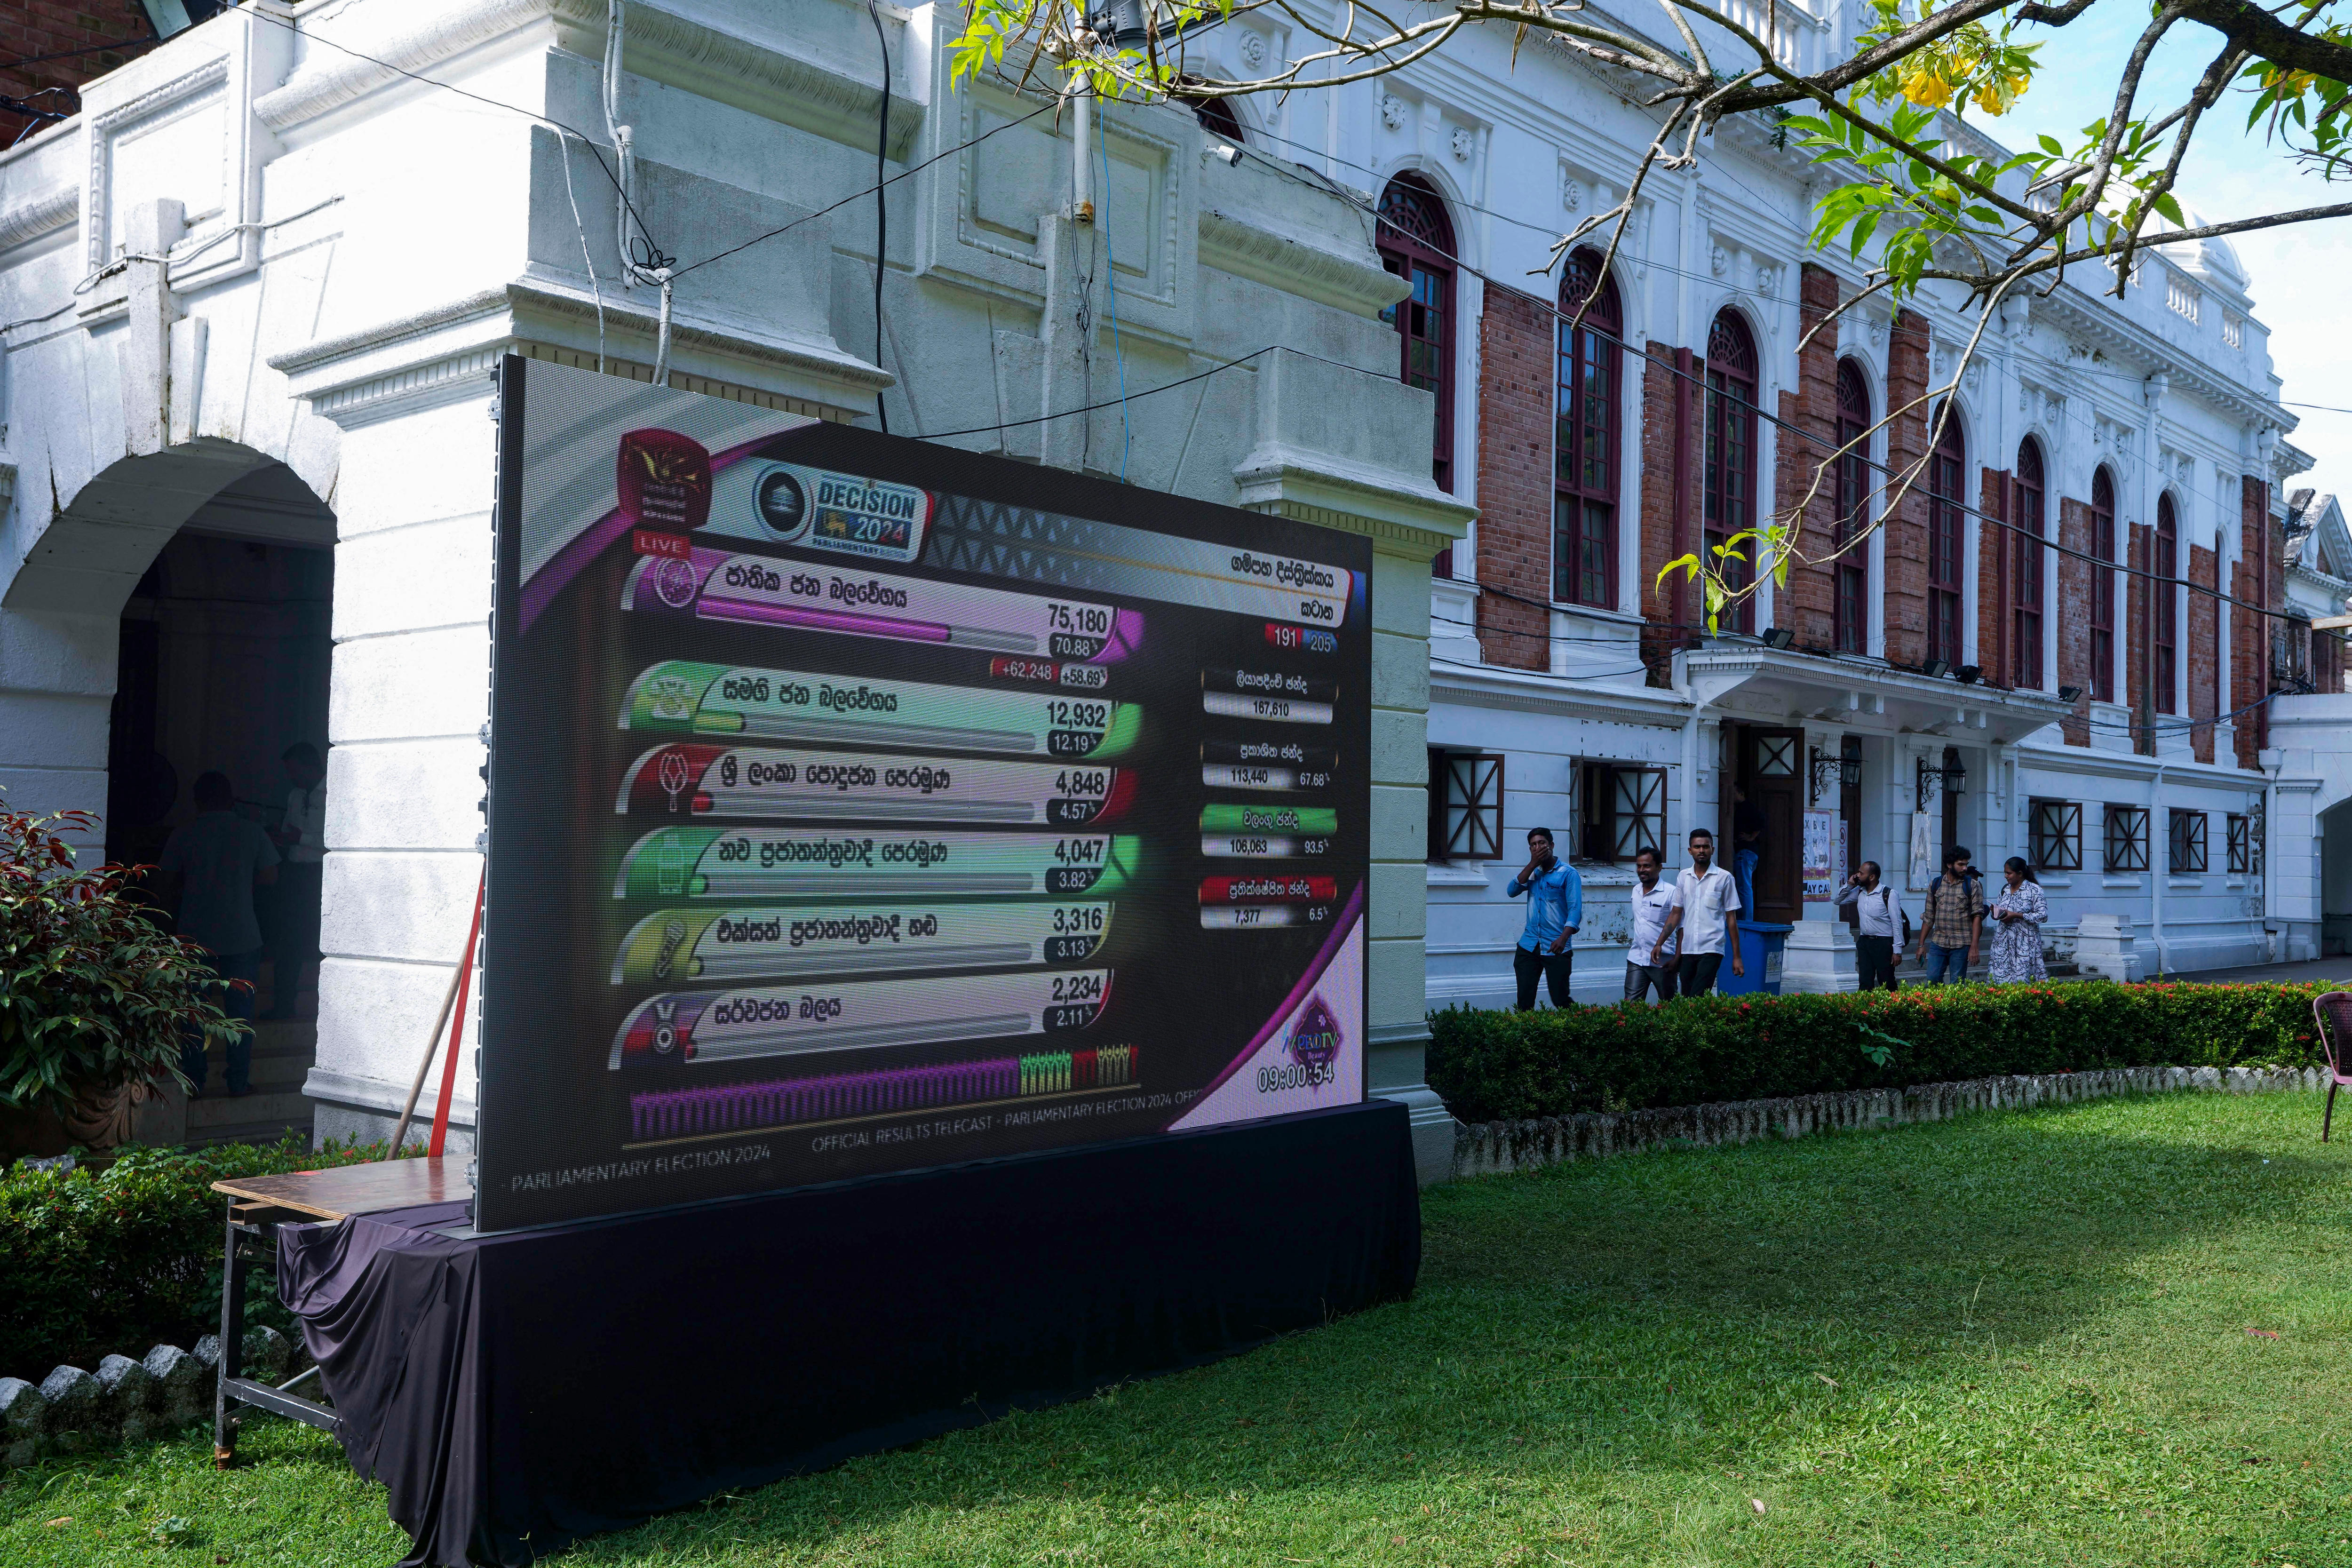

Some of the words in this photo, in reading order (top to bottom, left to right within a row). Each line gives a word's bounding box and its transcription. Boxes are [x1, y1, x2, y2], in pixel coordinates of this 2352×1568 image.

[818, 481, 916, 519] DECISION
[854, 516, 905, 543] 2024
[640, 536, 683, 553] LIVE
[1231, 552, 1272, 576] ගම්පහ
[725, 563, 781, 592] ජාතික
[790, 573, 821, 597] ජන
[829, 576, 907, 608] බලවේගය
[1048, 603, 1107, 634] 75,180
[1301, 600, 1334, 621] කටාන
[1274, 627, 1296, 647] 191
[1311, 635, 1332, 653] 205
[1003, 661, 1052, 681] +62,248
[723, 676, 770, 702] සමගි
[779, 682, 810, 705] ජන
[818, 684, 898, 713] බලවේගය
[1047, 700, 1106, 730] 12,932
[1253, 700, 1290, 717] 167,610
[747, 761, 796, 787] ලංකා
[806, 763, 876, 791] පොදුජන
[1056, 771, 1105, 798] 4,848
[1231, 768, 1269, 784] 113,440
[719, 837, 751, 861] නව
[1054, 839, 1104, 867] 4,047
[1230, 839, 1267, 855] 106,063
[716, 915, 781, 942] එක්සත්
[1053, 907, 1103, 934] 3,316
[1235, 909, 1261, 925] 7,377
[1052, 976, 1102, 1005] 2,234
[799, 995, 841, 1022] බලය
[1257, 1060, 1335, 1093] 09:00:54
[812, 1131, 869, 1153] OFFICIAL
[876, 1123, 930, 1144] RESULTS
[934, 1115, 993, 1136] TELECAST
[1004, 1103, 1095, 1126] PARLIAMENTARY
[1096, 1097, 1145, 1114] ELECTION
[1148, 1093, 1172, 1108] 2024
[512, 1159, 651, 1192] PARLIAMENTARY
[655, 1149, 731, 1173] ELECTION
[735, 1144, 771, 1163] 2024
